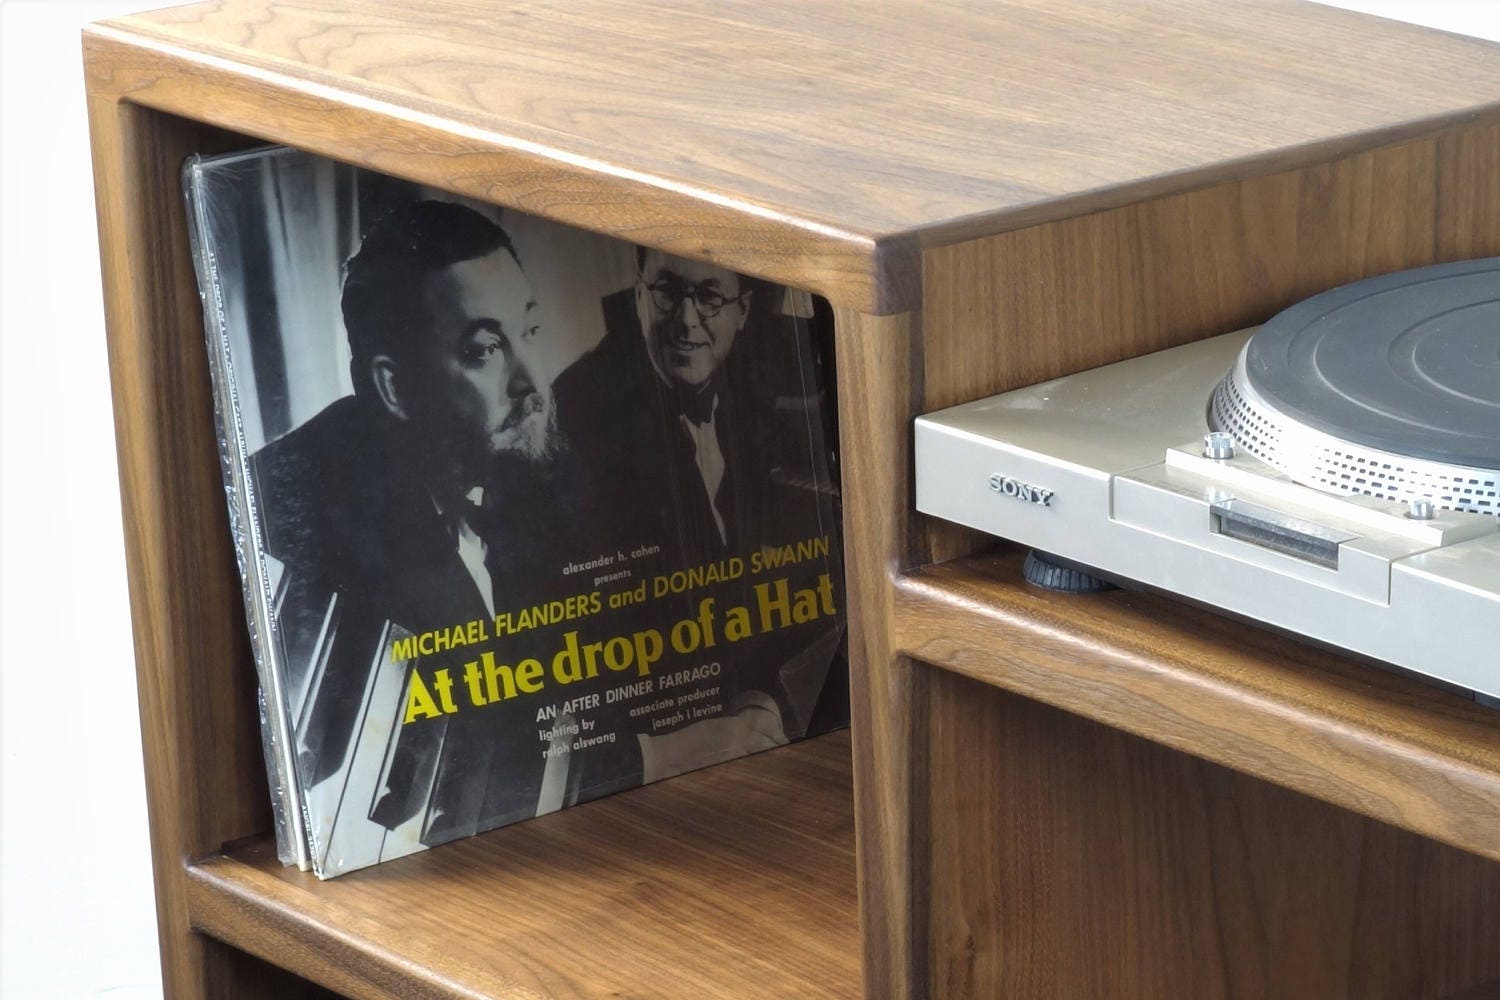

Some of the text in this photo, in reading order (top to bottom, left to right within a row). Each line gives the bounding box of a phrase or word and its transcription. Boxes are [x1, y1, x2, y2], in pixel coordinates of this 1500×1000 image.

[989, 472, 1054, 506] SONY
[563, 544, 660, 575] alexander h. cohen
[594, 569, 631, 587] presents
[391, 536, 830, 663] MICHAEL FLANDERS and DONALD SWANN
[404, 573, 836, 724] At the drop of a Hat
[536, 662, 721, 723] AN AFTER DINNER FARRAGO
[630, 686, 720, 717] associate producer
[539, 719, 595, 741] lighting by
[652, 712, 684, 730] joseph
[694, 703, 722, 718] levine
[573, 732, 616, 751] alswang
